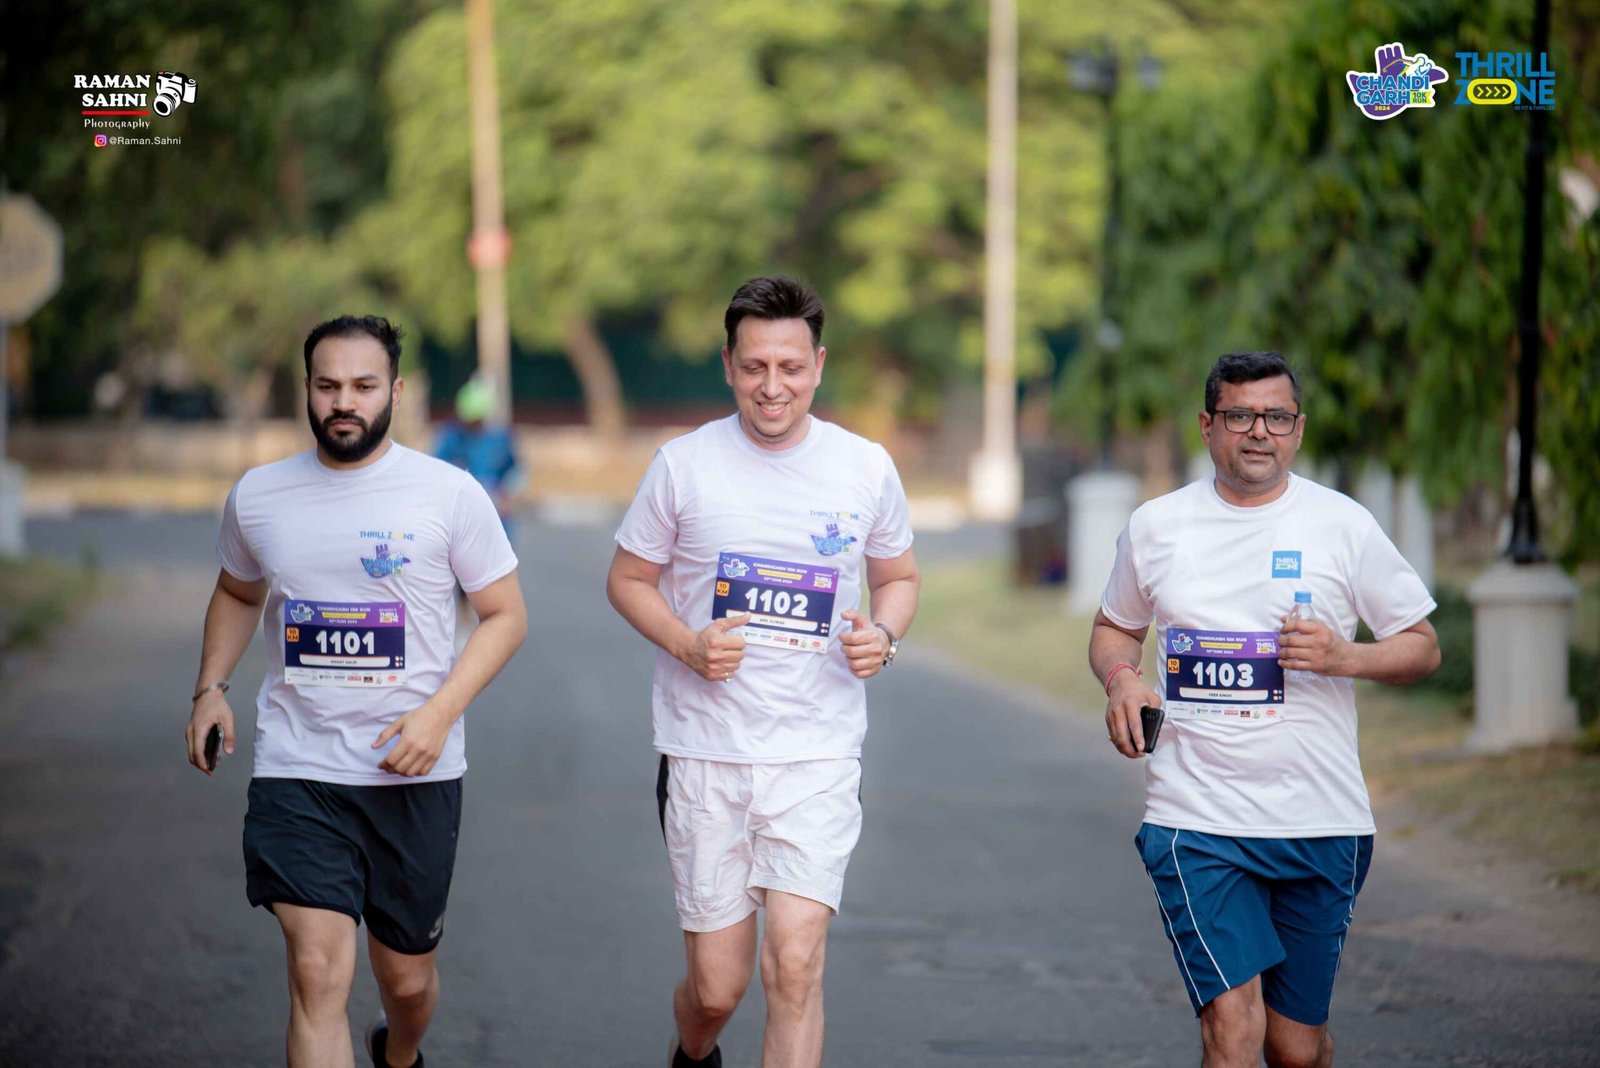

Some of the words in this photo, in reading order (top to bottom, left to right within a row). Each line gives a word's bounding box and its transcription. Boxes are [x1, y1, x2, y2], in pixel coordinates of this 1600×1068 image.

[360, 531, 385, 539] THRILL
[745, 587, 809, 617] 1102
[316, 630, 375, 655] 1101
[1192, 661, 1254, 688] 1103
